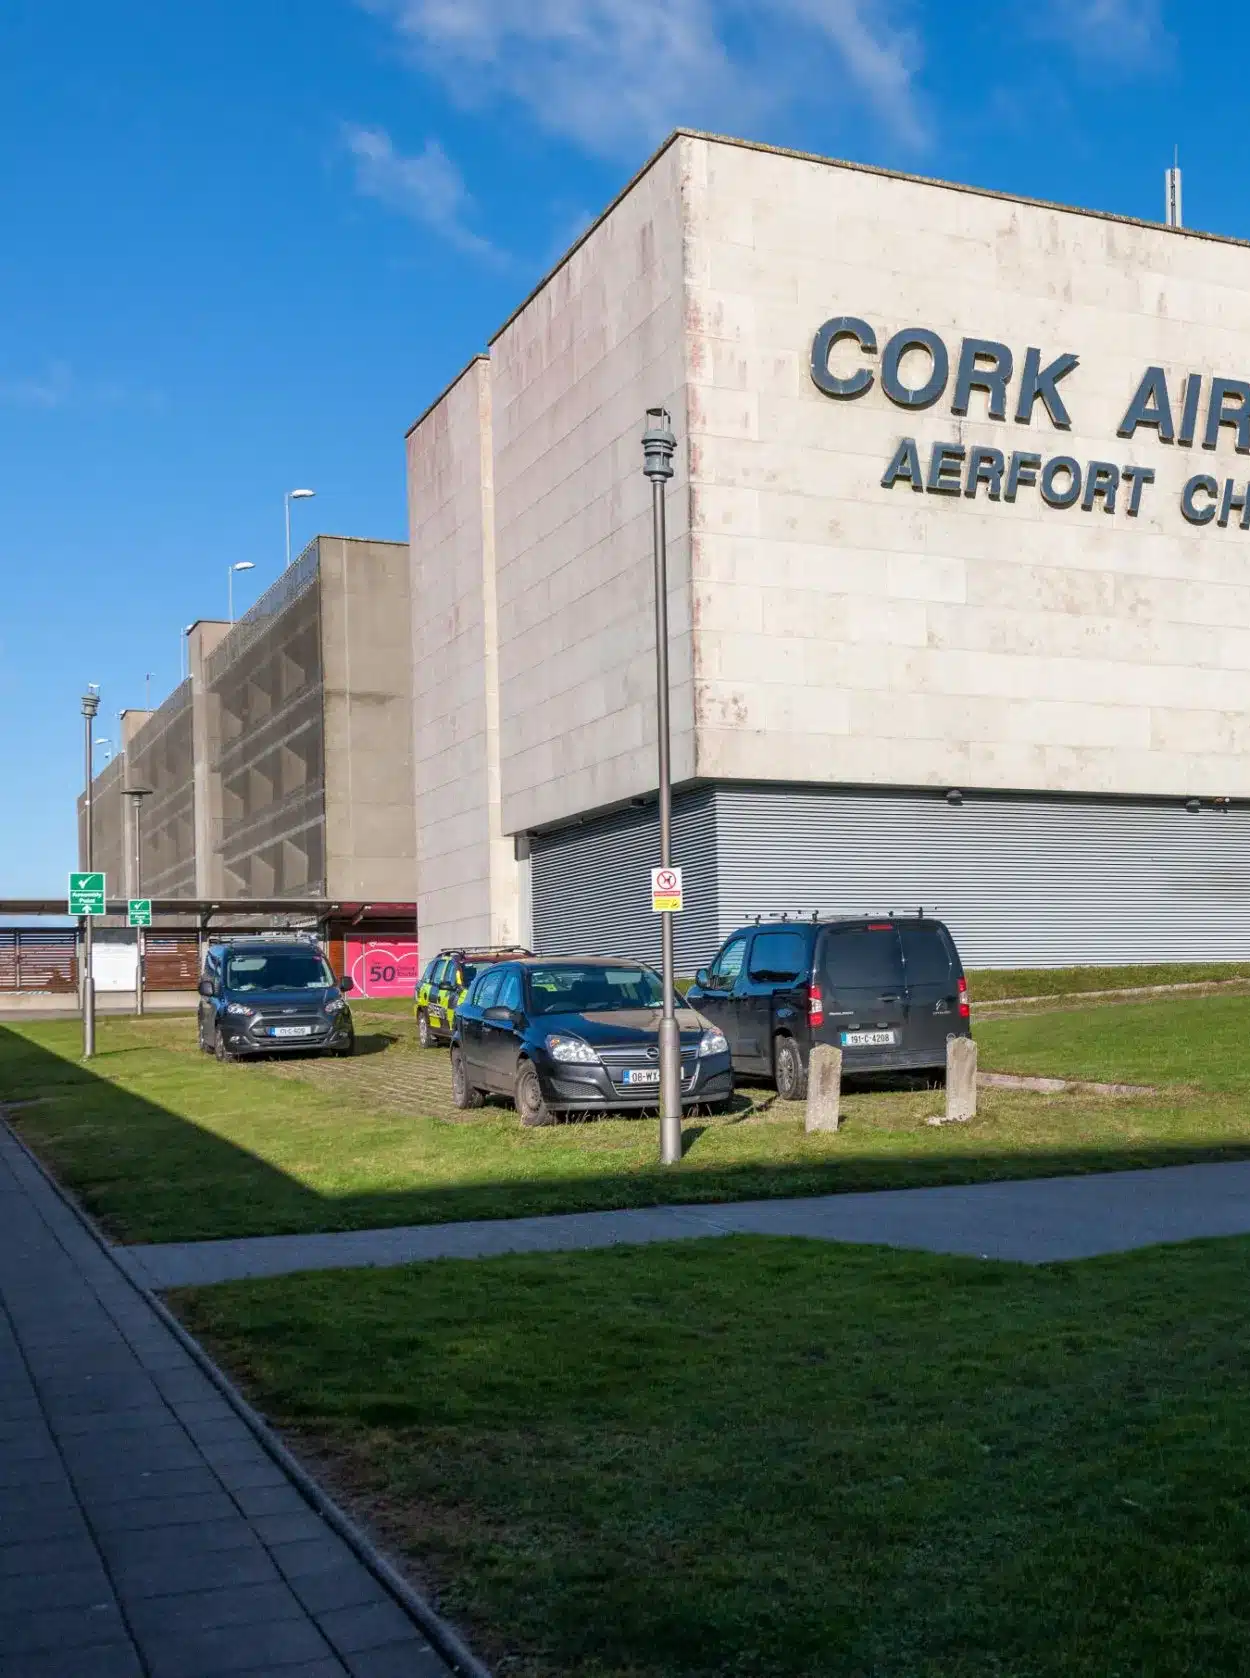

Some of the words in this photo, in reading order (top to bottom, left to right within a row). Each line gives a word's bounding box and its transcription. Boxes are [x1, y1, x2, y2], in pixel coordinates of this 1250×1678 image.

[809, 315, 1080, 430] CORK
[881, 438, 1155, 517] AERFORT
[370, 966, 396, 982] 50
